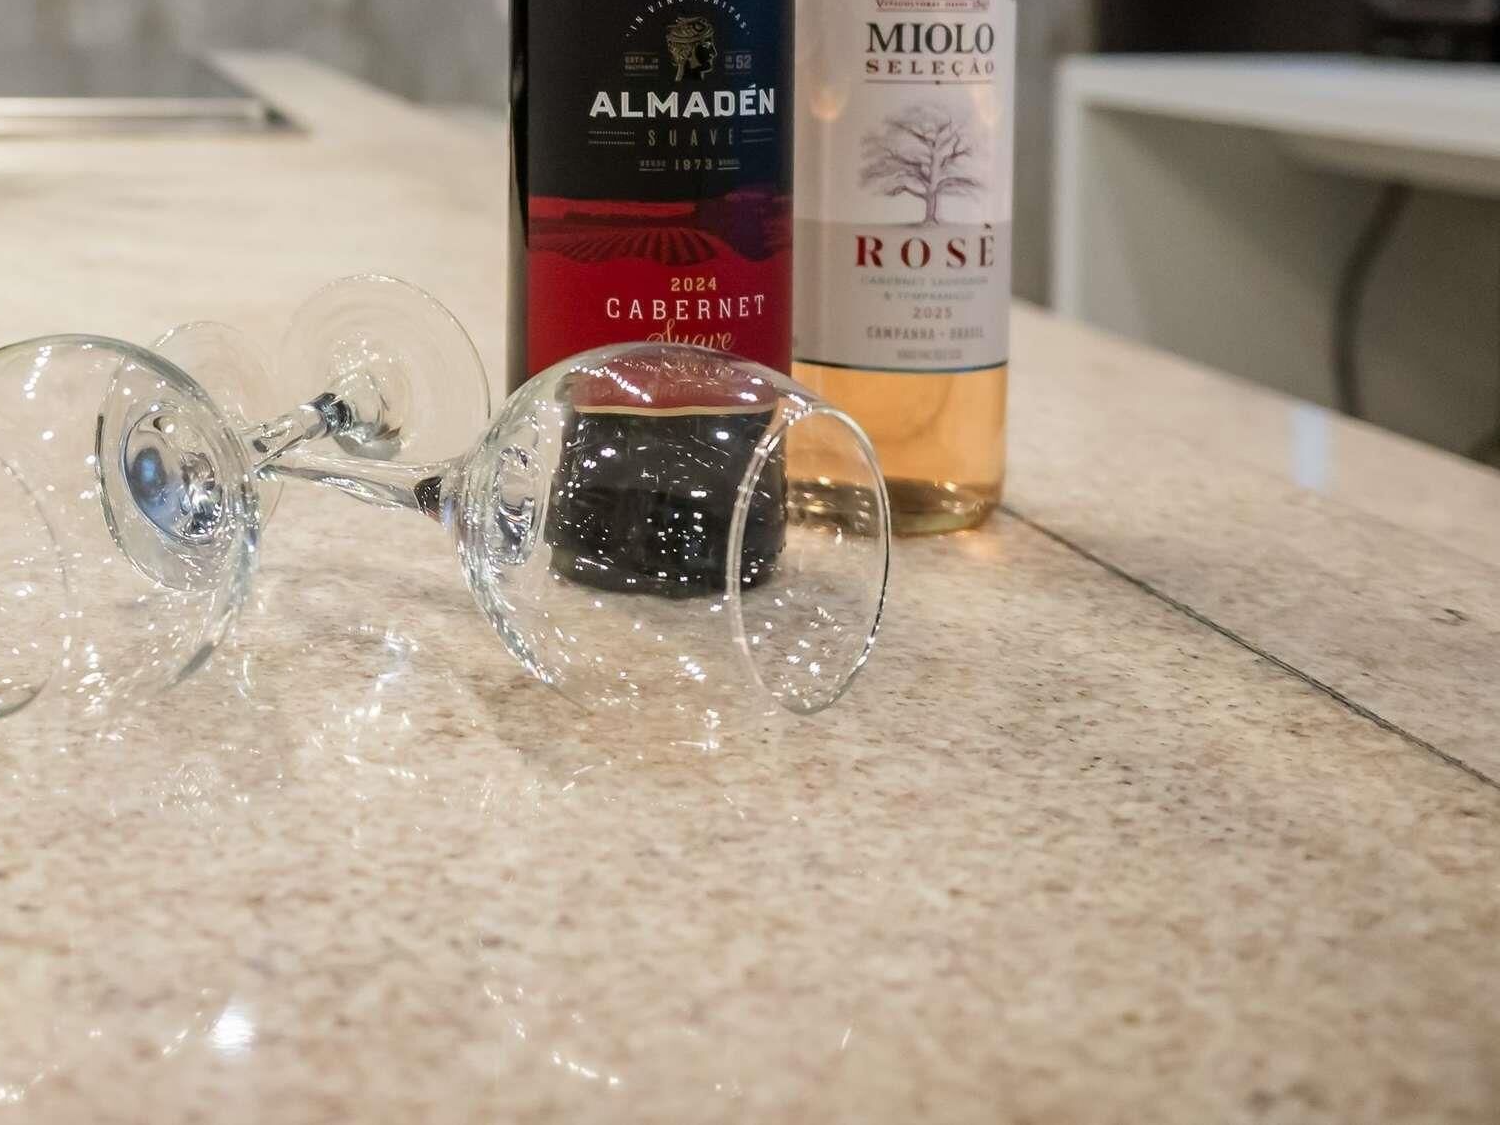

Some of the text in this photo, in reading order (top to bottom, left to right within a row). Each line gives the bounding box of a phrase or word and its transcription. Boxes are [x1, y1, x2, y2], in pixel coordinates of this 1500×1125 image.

[866, 23, 994, 54] MIOLO
[866, 59, 994, 76] SELEÇÃO
[589, 84, 774, 118] ALMADÉN
[647, 127, 735, 147] SUAVE
[670, 277, 717, 292] 2024
[606, 295, 764, 319] CABERNET
